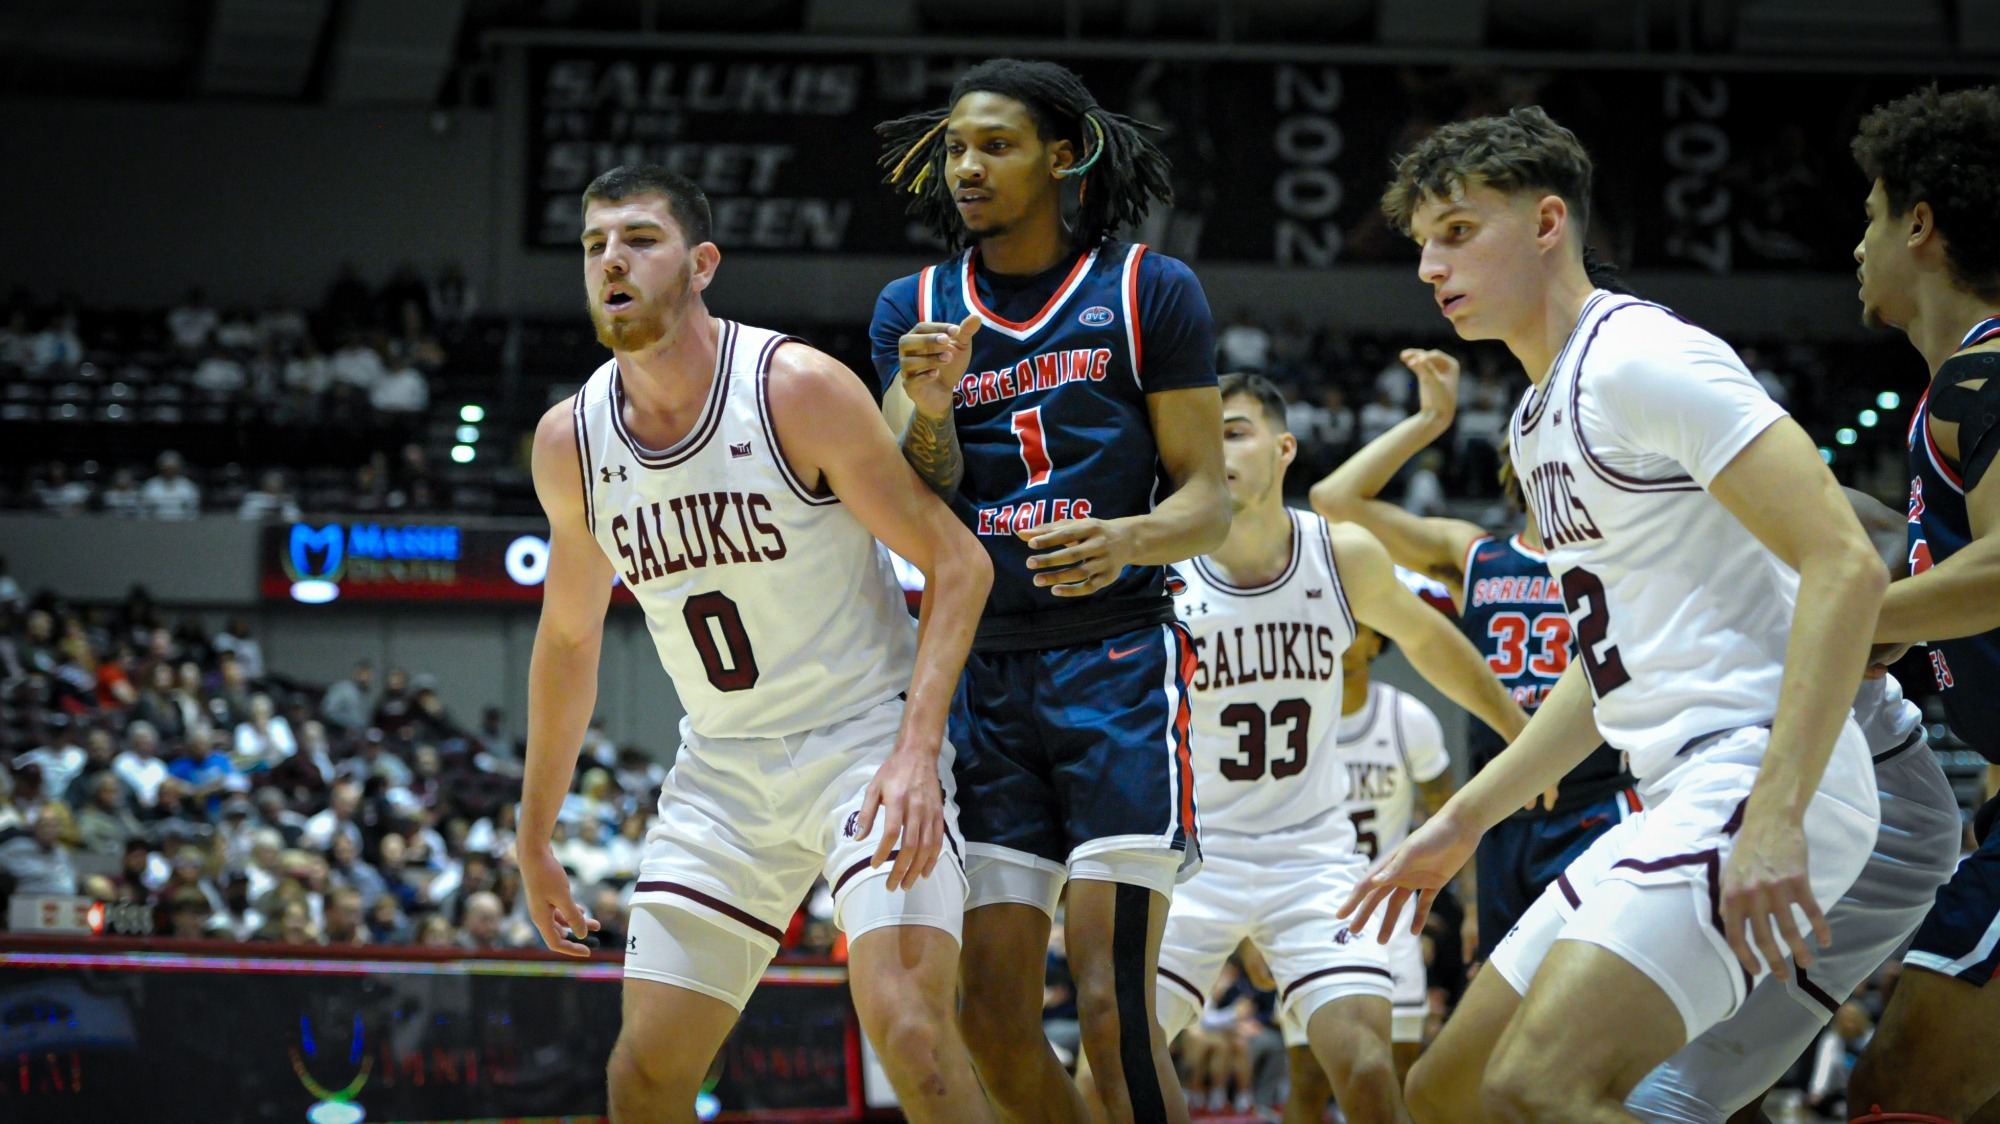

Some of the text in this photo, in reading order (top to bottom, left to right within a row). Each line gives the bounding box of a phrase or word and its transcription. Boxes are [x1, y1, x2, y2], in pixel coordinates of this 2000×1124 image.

[1274, 65, 1343, 266] 2002
[953, 348, 1112, 409] SCREAMING
[1011, 405, 1053, 489] 1
[612, 491, 787, 586] SALUKIS
[682, 590, 759, 692] 0
[1193, 622, 1334, 692] SALUKIS
[1486, 611, 1574, 680] 33
[1560, 565, 1631, 700] 2
[1220, 698, 1311, 781] 33
